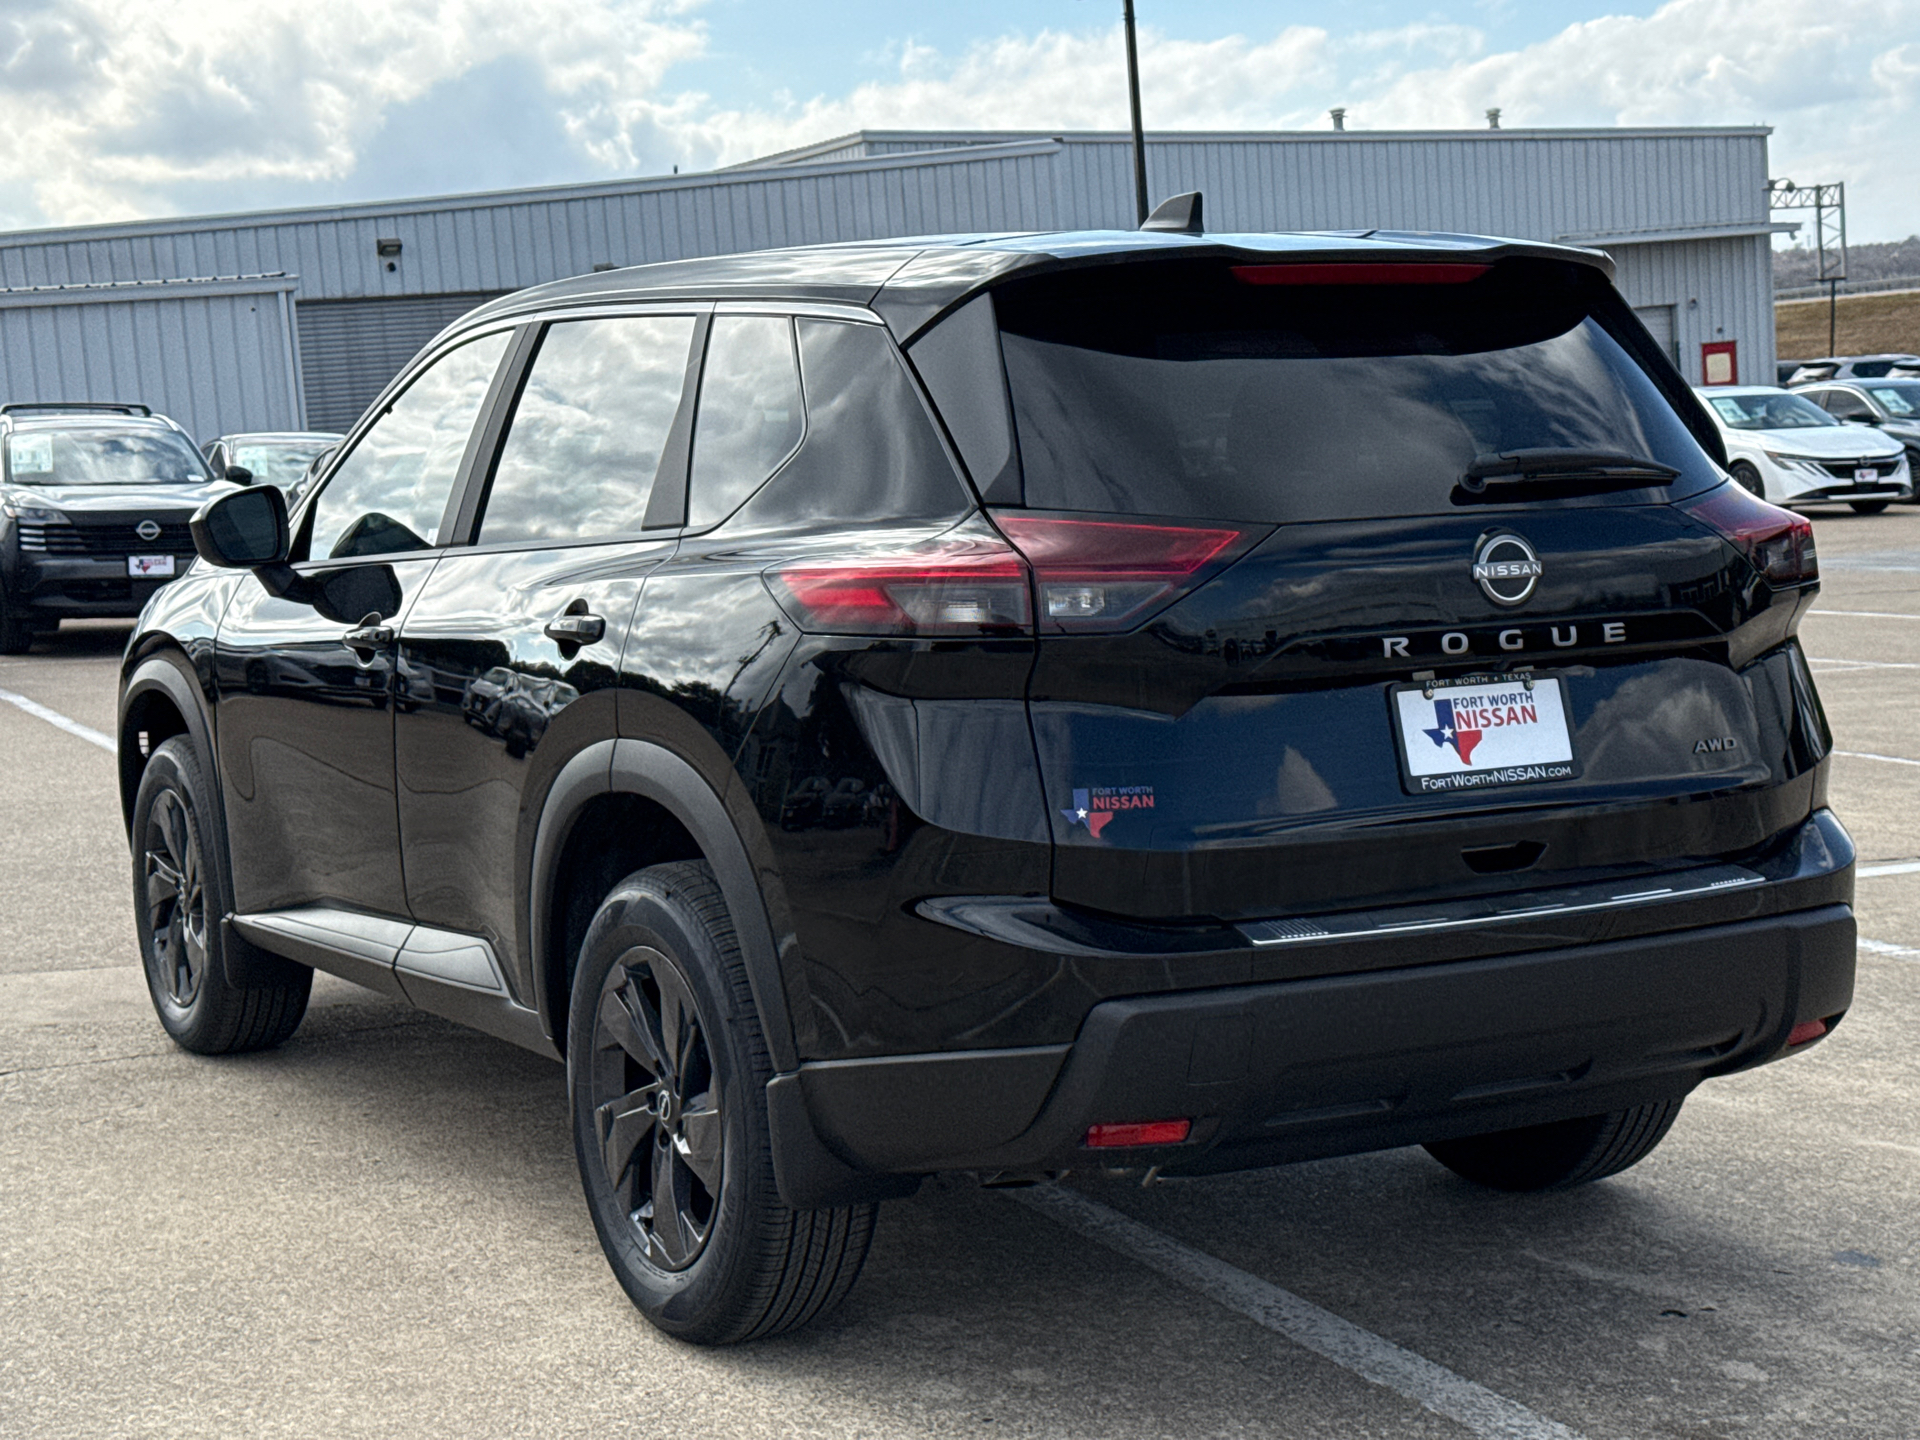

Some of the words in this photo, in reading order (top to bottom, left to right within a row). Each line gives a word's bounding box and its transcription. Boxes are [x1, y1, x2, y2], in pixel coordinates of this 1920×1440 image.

[1476, 563, 1542, 578] NISSAN
[1382, 622, 1627, 658] ROGUE
[1426, 679, 1450, 689] FORT
[1455, 676, 1488, 686] WORTH
[1502, 672, 1532, 681] TEXAS
[1453, 696, 1485, 709] FORT
[1487, 691, 1534, 707] WORTH
[1455, 704, 1538, 730] NISSAN
[1693, 737, 1737, 754] AWD
[1092, 787, 1117, 796] FORT
[1119, 786, 1153, 794] WORTH
[1093, 795, 1154, 809] NISSAN
